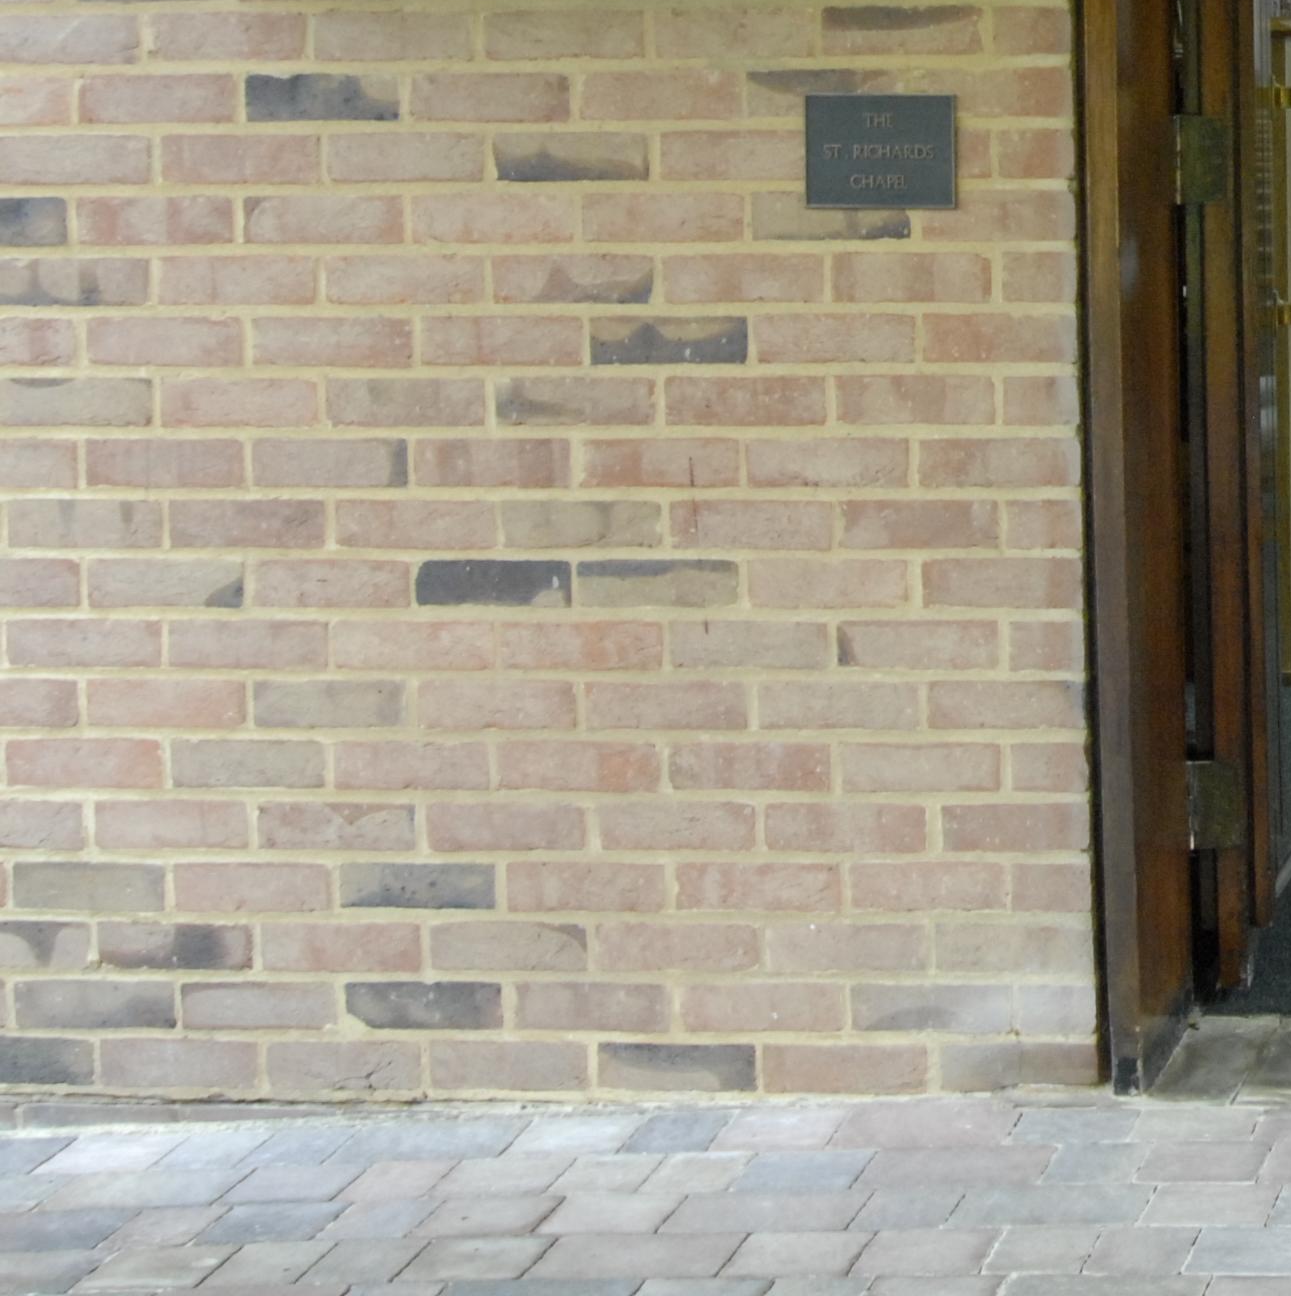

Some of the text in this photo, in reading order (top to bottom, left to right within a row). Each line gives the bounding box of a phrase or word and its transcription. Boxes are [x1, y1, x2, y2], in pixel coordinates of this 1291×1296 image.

[862, 113, 894, 128] THE
[852, 144, 936, 160] RICHARDS
[849, 174, 908, 189] CHAPEL
